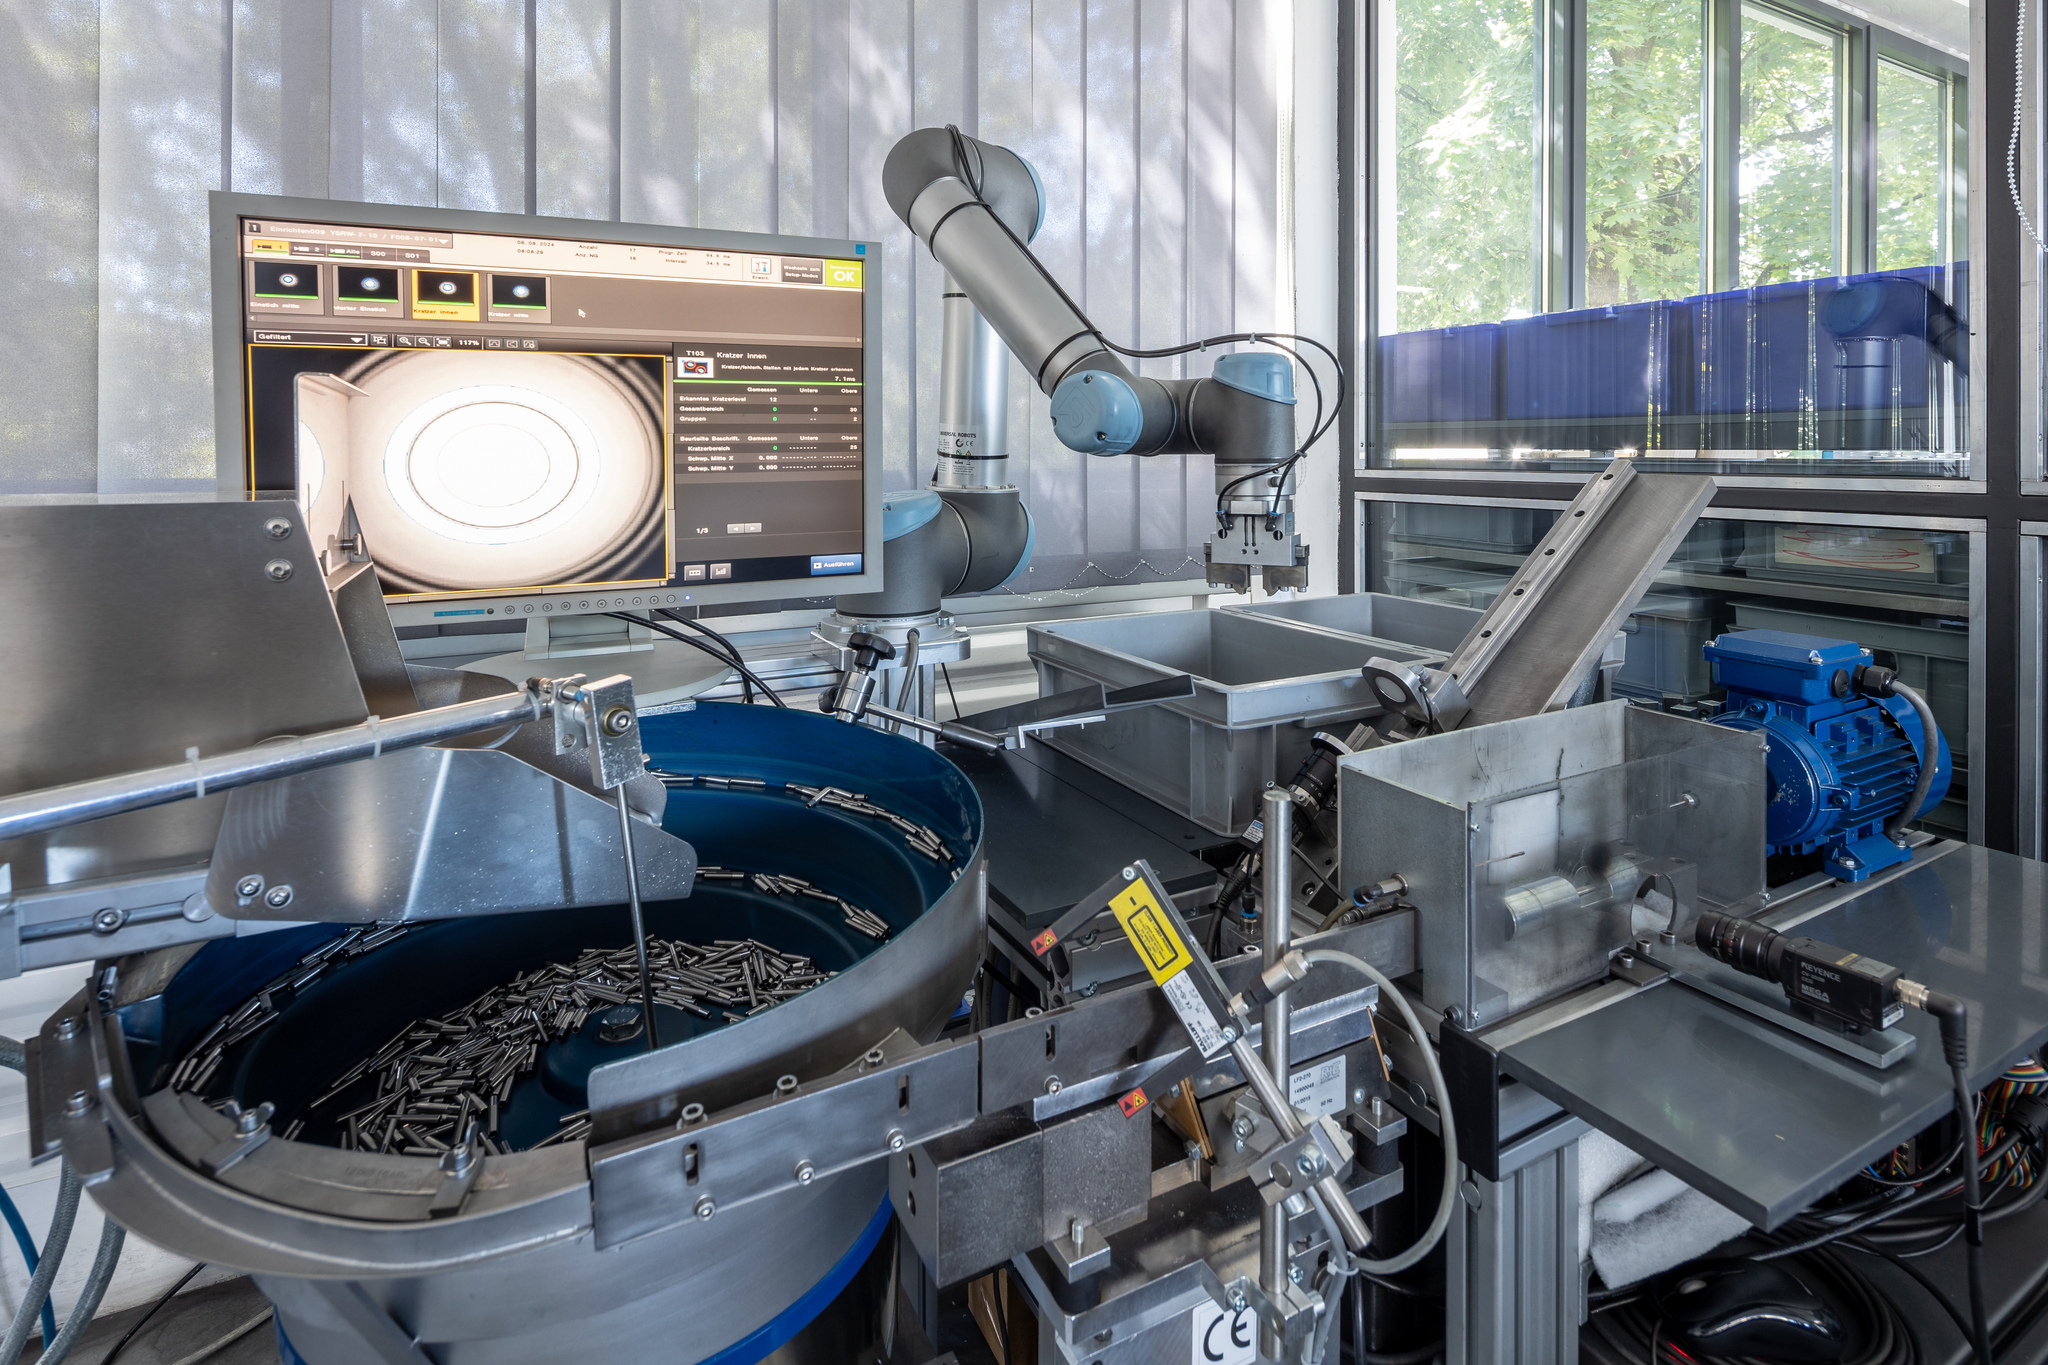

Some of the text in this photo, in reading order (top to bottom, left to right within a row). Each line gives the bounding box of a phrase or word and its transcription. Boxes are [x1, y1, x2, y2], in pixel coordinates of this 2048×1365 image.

[270, 226, 326, 235] Einrichten009
[834, 270, 855, 282] OK
[1800, 961, 1840, 982] KEYENCE
[1801, 983, 1830, 999] MEGA
[1187, 1022, 1208, 1052] BALLUFF
[1294, 1072, 1311, 1083] LF2-270
[1203, 1306, 1250, 1362] CE
